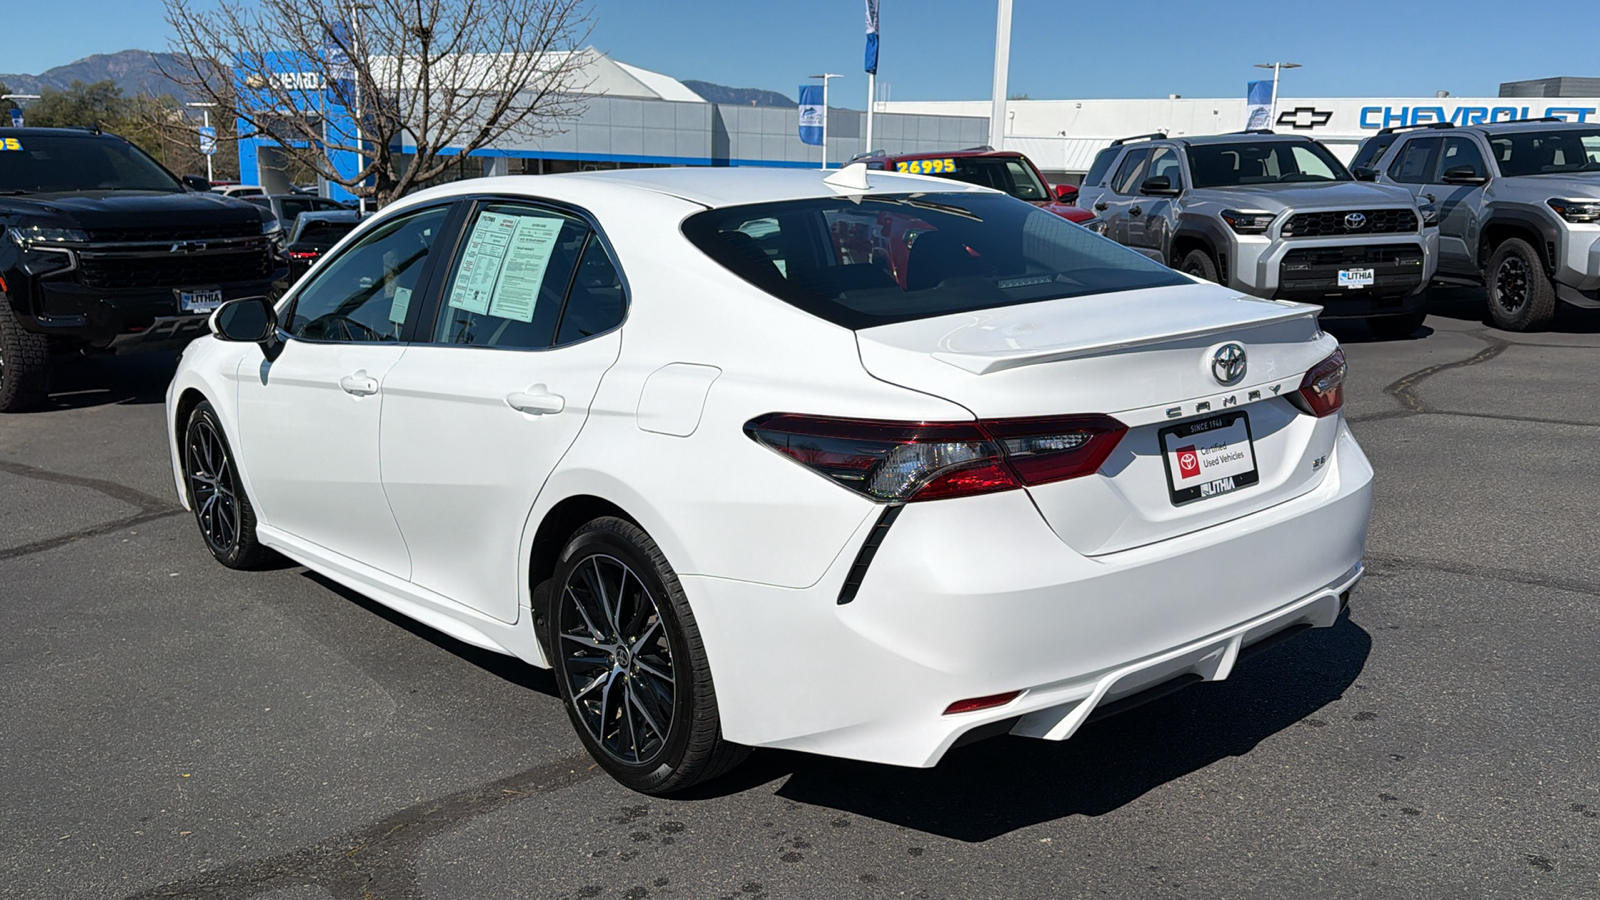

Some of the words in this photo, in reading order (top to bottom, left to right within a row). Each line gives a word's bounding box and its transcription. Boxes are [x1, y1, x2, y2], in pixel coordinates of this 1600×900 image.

[897, 159, 955, 174] 26995
[1347, 271, 1373, 280] LITHIA
[190, 293, 220, 303] LITHIA
[1166, 384, 1281, 418] CAMRY
[1190, 422, 1209, 433] SINCE
[1209, 419, 1223, 429] 1946
[1200, 441, 1227, 456] Certified
[1203, 457, 1219, 468] Used
[1219, 451, 1244, 463] Vehicles
[1208, 476, 1235, 494] LITHIA
